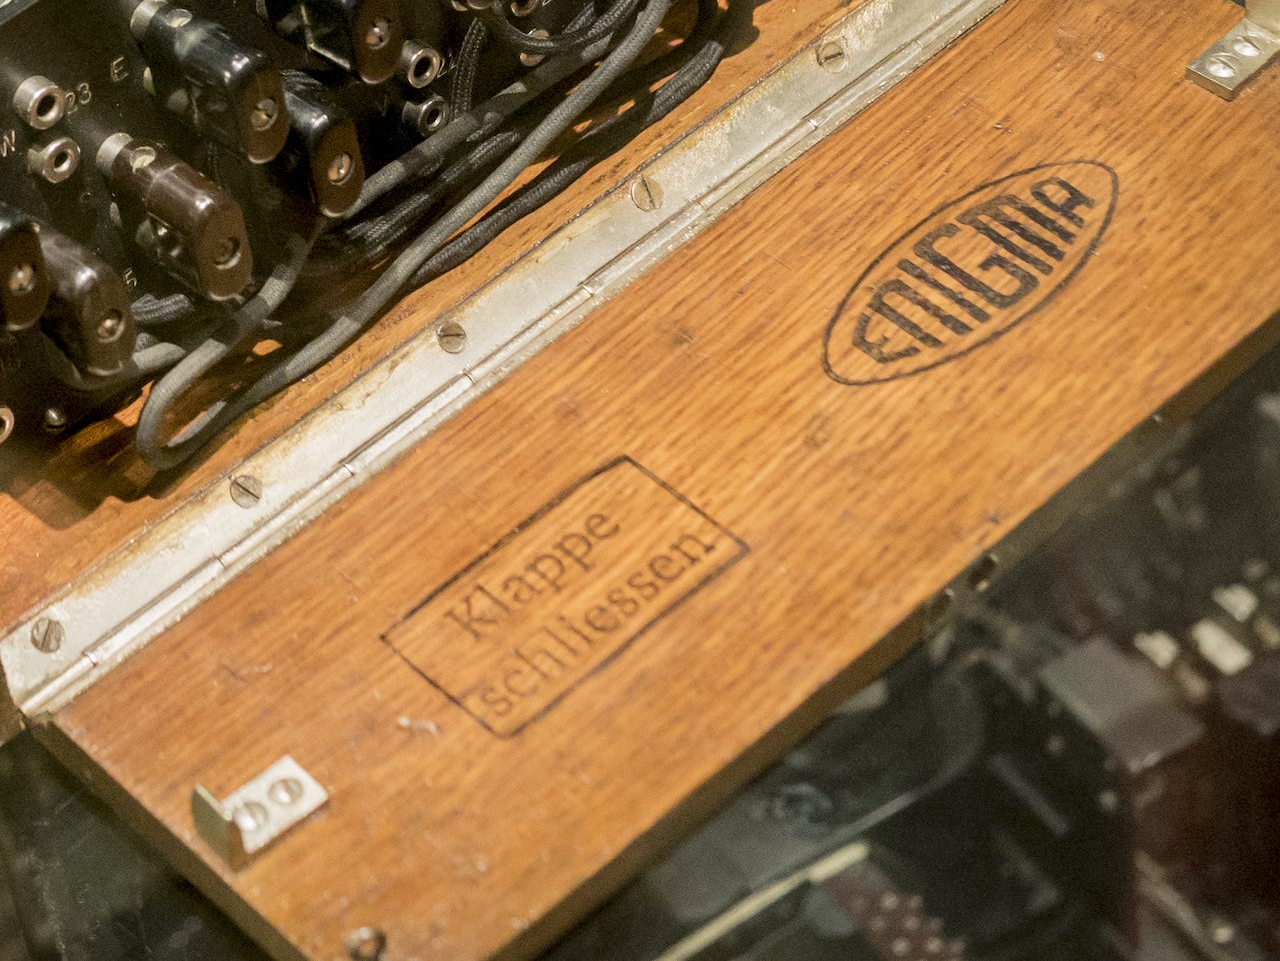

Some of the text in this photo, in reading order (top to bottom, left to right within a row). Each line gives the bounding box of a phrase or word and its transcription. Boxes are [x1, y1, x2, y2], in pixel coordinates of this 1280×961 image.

[65, 82, 92, 114] 23
[111, 56, 128, 82] E
[851, 177, 1095, 364] ENIGMA
[444, 513, 620, 640] Klappe
[480, 534, 715, 717] schliessen
